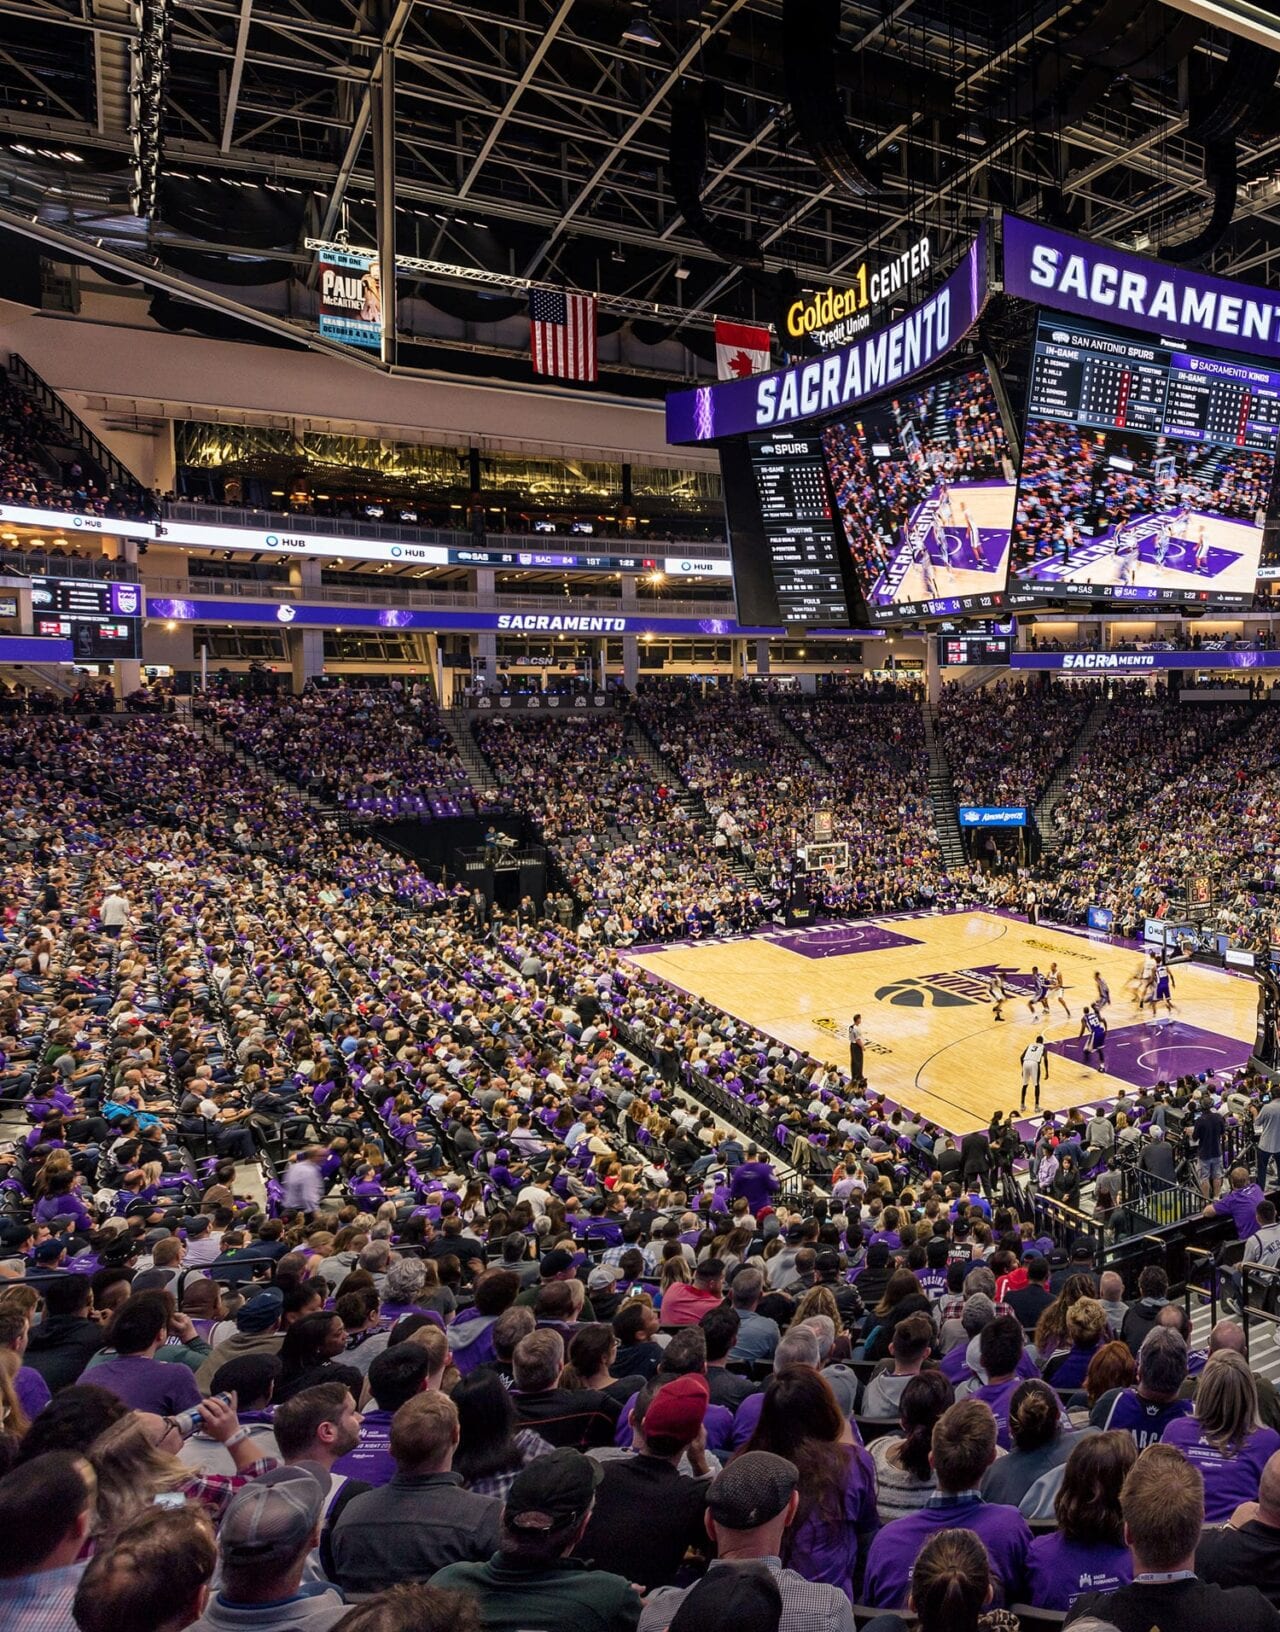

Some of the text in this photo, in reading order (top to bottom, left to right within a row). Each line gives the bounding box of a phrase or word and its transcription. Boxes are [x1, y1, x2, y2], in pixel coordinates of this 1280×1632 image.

[870, 237, 930, 303] CENTER
[322, 269, 366, 301] PAUL
[322, 295, 365, 311] McCARTNEY
[787, 262, 868, 337] Golden 1
[819, 313, 870, 346] Credit Union
[1046, 346, 1079, 360] IN-GAME
[1071, 334, 1154, 361] SAN ANTONIO SPURS
[755, 286, 951, 425] SACRAMENTO
[1178, 372, 1207, 384] IN-GAME
[1198, 361, 1270, 383] SACRAMENTO KINGS
[1040, 406, 1074, 418] TEAM TOTALS
[775, 442, 809, 455] SPURS
[84, 520, 102, 529] HUB
[282, 538, 306, 548] HUB
[404, 549, 426, 558] HUB
[472, 553, 634, 567] SAS 21 SAC 24 1ST 1:22
[693, 563, 713, 571] HUB
[1078, 585, 1196, 600] SAS 21 SAC 24 1ST 1:22
[906, 604, 916, 615] SAS
[922, 604, 928, 613] 21
[935, 601, 945, 611] SAC
[952, 600, 960, 609] 24
[963, 598, 972, 608] 1ST
[980, 597, 991, 607] 1:22
[497, 615, 626, 631] SACRAMENTO
[530, 656, 553, 665] CSN
[1062, 654, 1154, 668] SACRAMENTO
[1031, 1045, 1039, 1053] 3
[1188, 1449, 1211, 1457] OPENING
